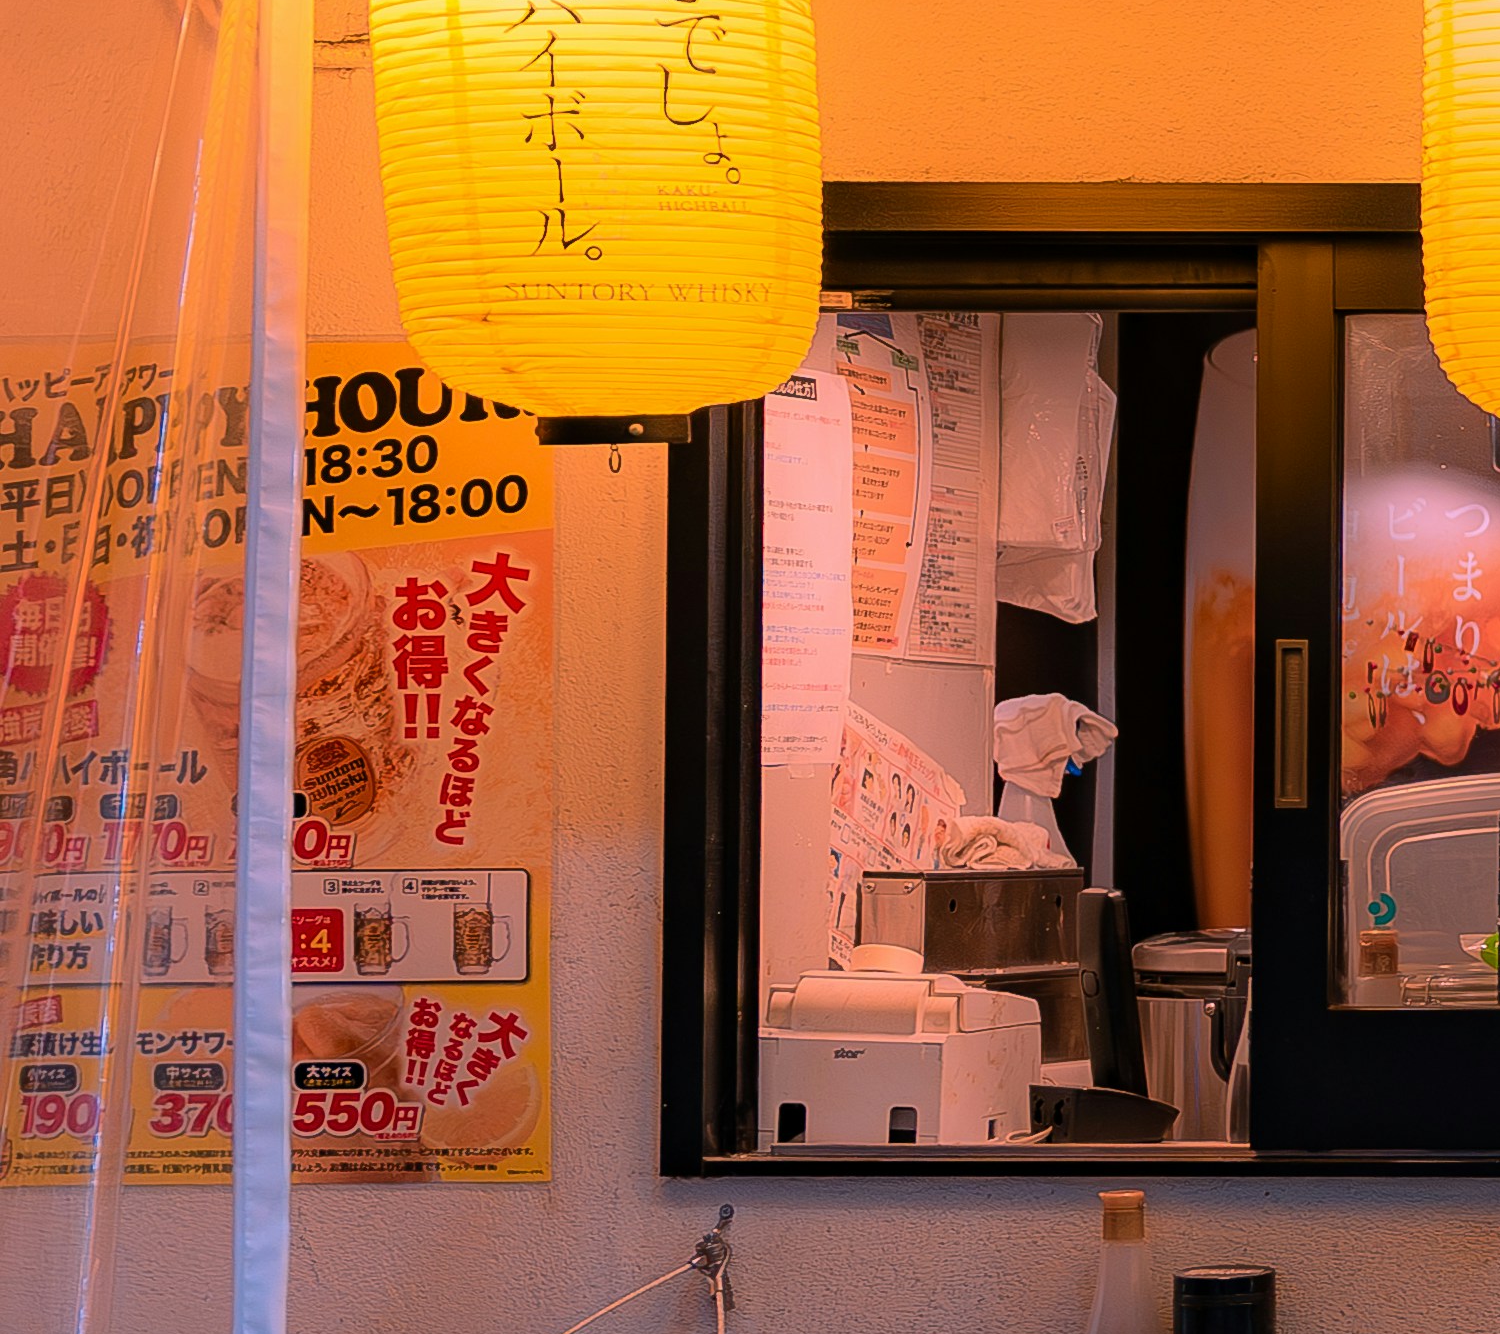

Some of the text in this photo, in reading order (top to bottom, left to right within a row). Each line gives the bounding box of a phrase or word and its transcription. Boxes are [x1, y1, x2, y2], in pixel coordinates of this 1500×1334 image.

[503, 281, 775, 304] SUNTORY WHISKY
[1444, 503, 1491, 657] つまり
[434, 552, 530, 846] 大きくなるほど
[306, 1064, 352, 1078] 大サイズ
[292, 1091, 420, 1133] 550円
